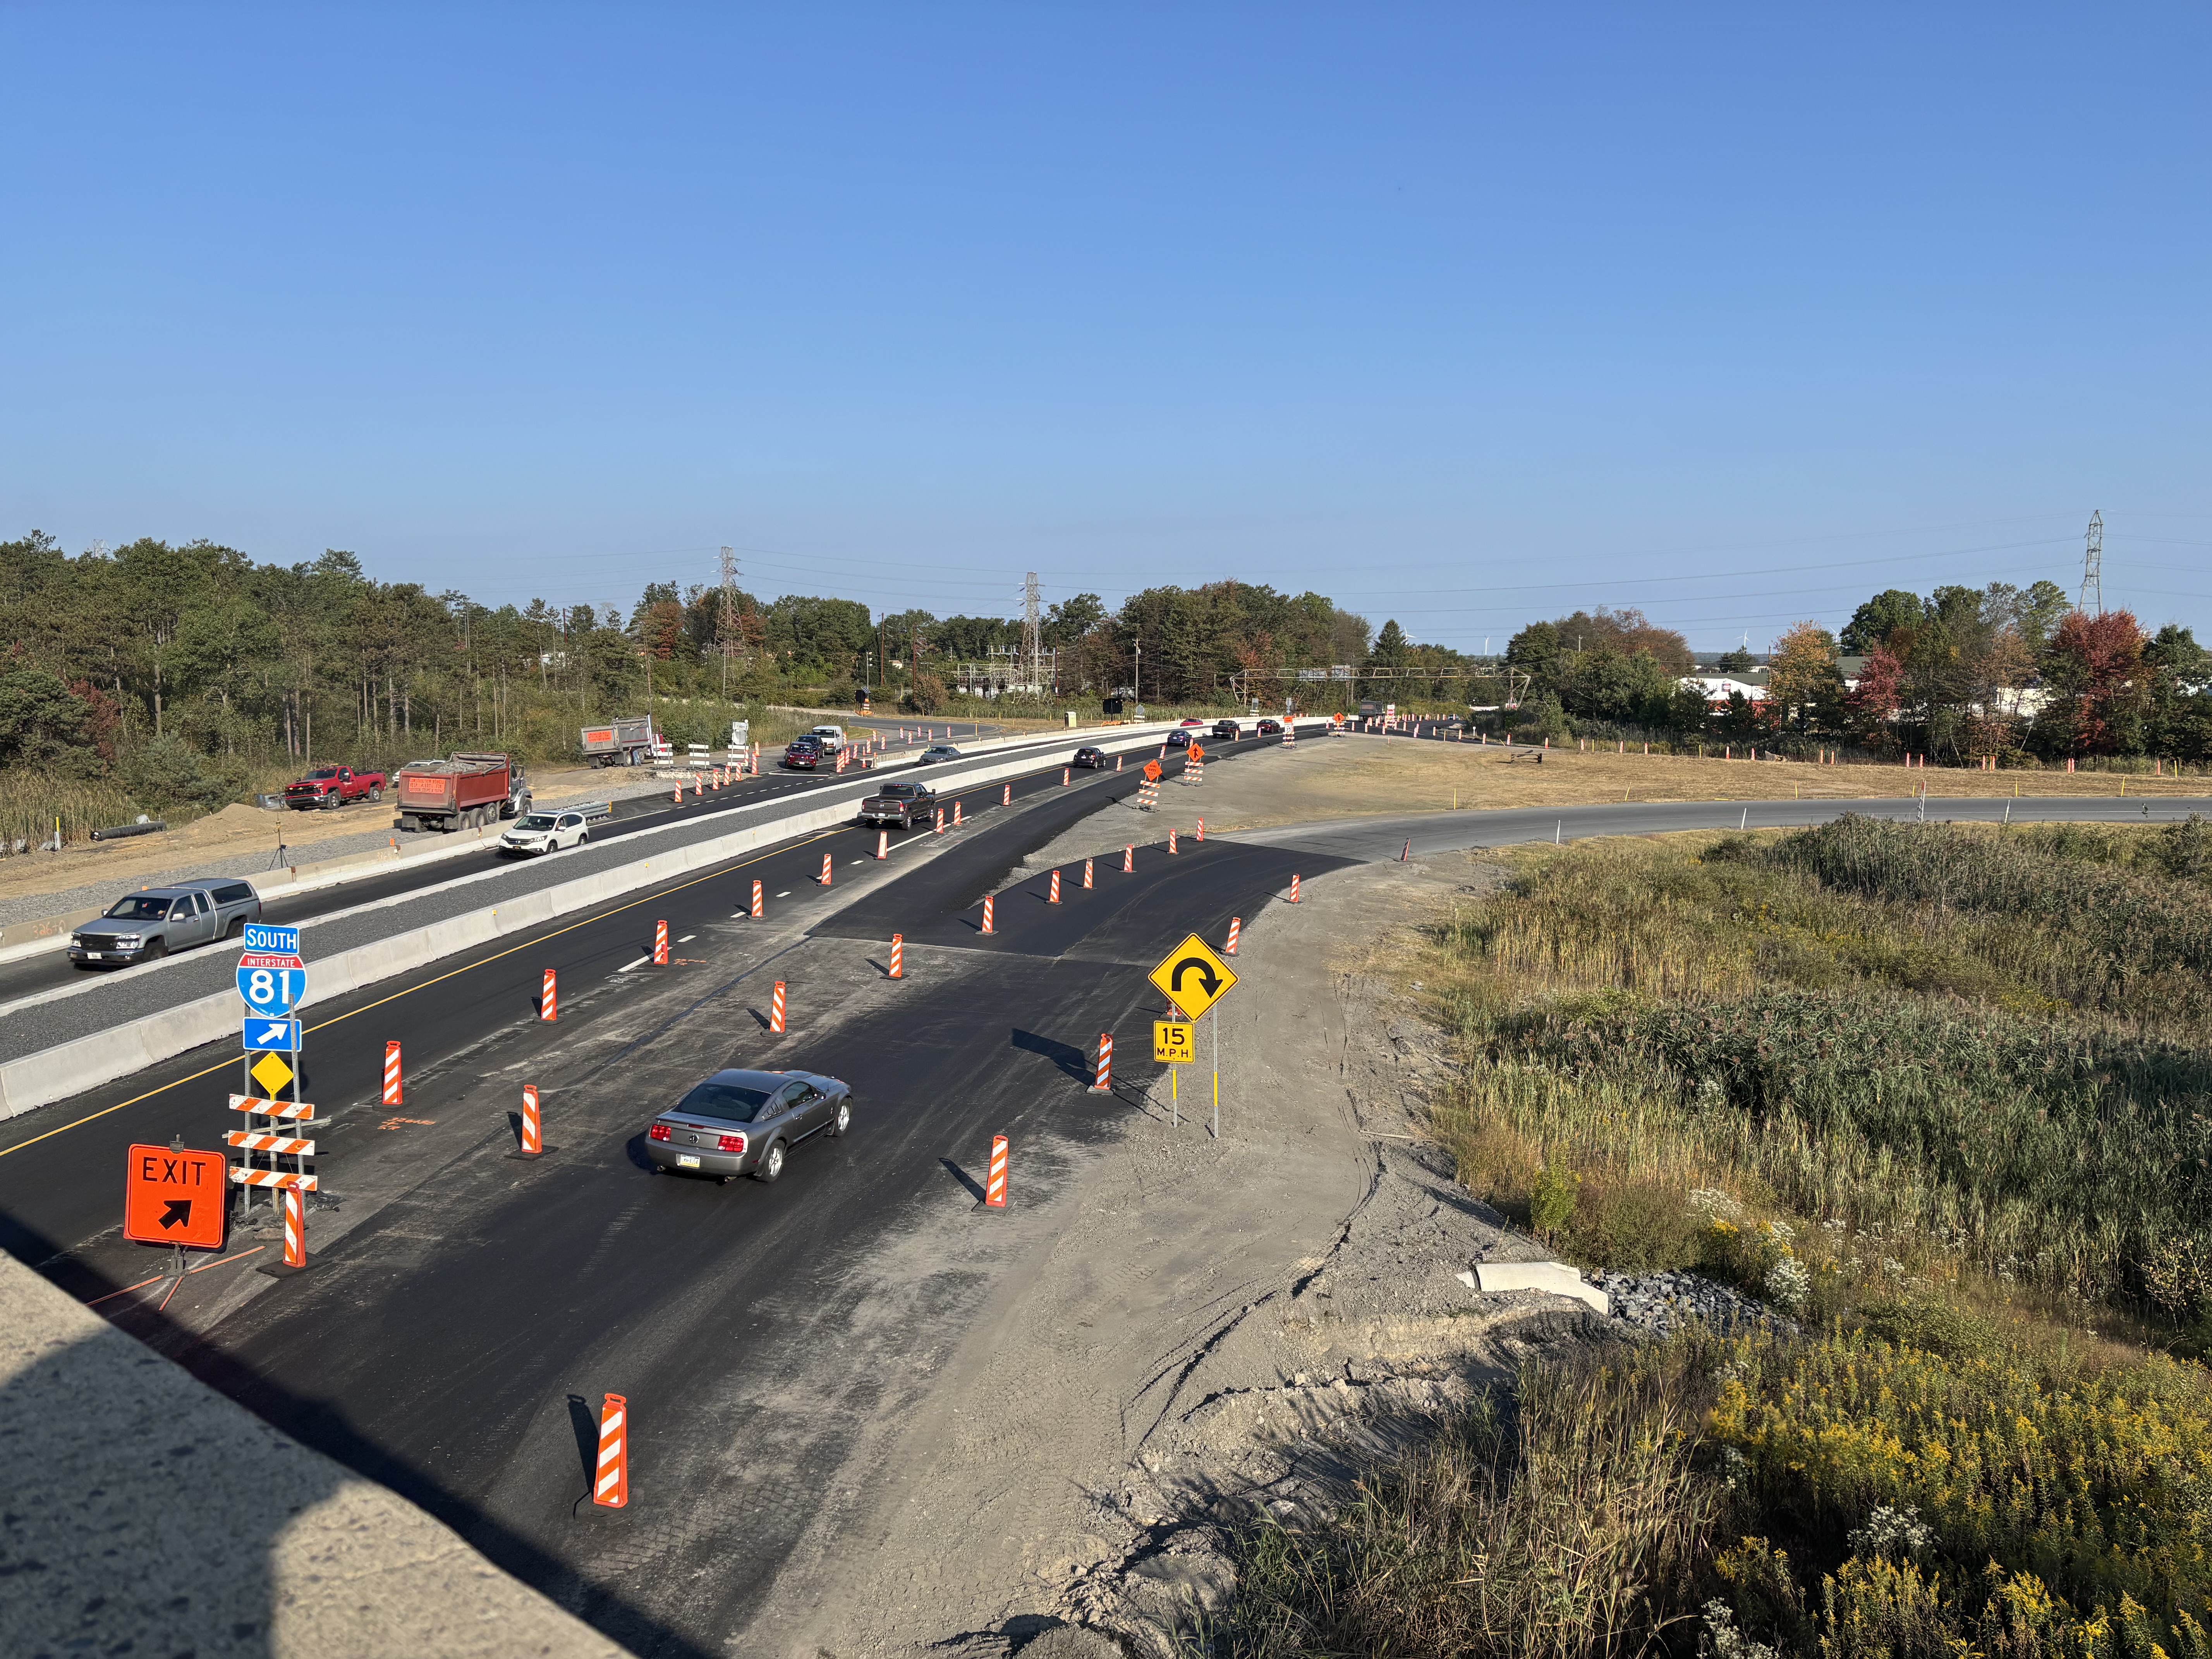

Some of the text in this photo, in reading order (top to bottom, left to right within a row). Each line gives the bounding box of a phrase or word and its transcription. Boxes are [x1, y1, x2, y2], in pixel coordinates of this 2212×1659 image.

[247, 929, 296, 949] SOUTH
[247, 958, 295, 967] INTERSTATE
[249, 970, 289, 1004] 81
[1163, 1027, 1185, 1045] 15
[1157, 1047, 1192, 1058] M.P.H.
[143, 1156, 206, 1186] EXIT
